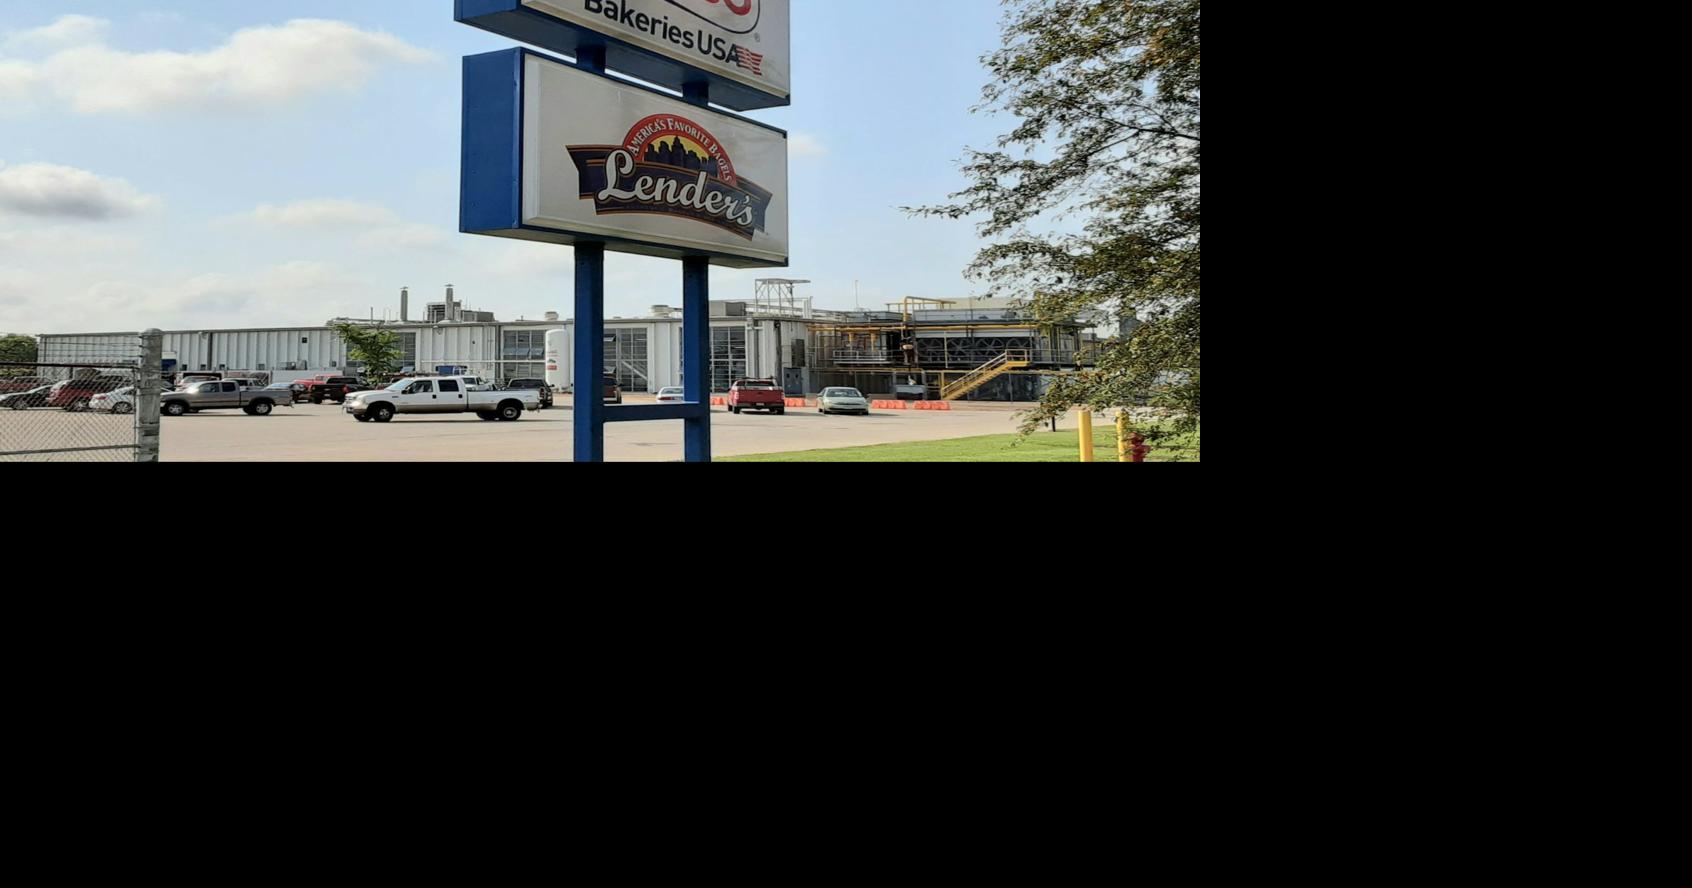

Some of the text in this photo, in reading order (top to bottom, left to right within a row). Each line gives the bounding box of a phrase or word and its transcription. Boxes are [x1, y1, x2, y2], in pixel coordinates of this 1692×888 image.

[584, 0, 743, 68] Bakeries USA
[667, 117, 711, 147] FAVORITE
[708, 143, 732, 182] BAGELS
[598, 149, 754, 227] Lender's
